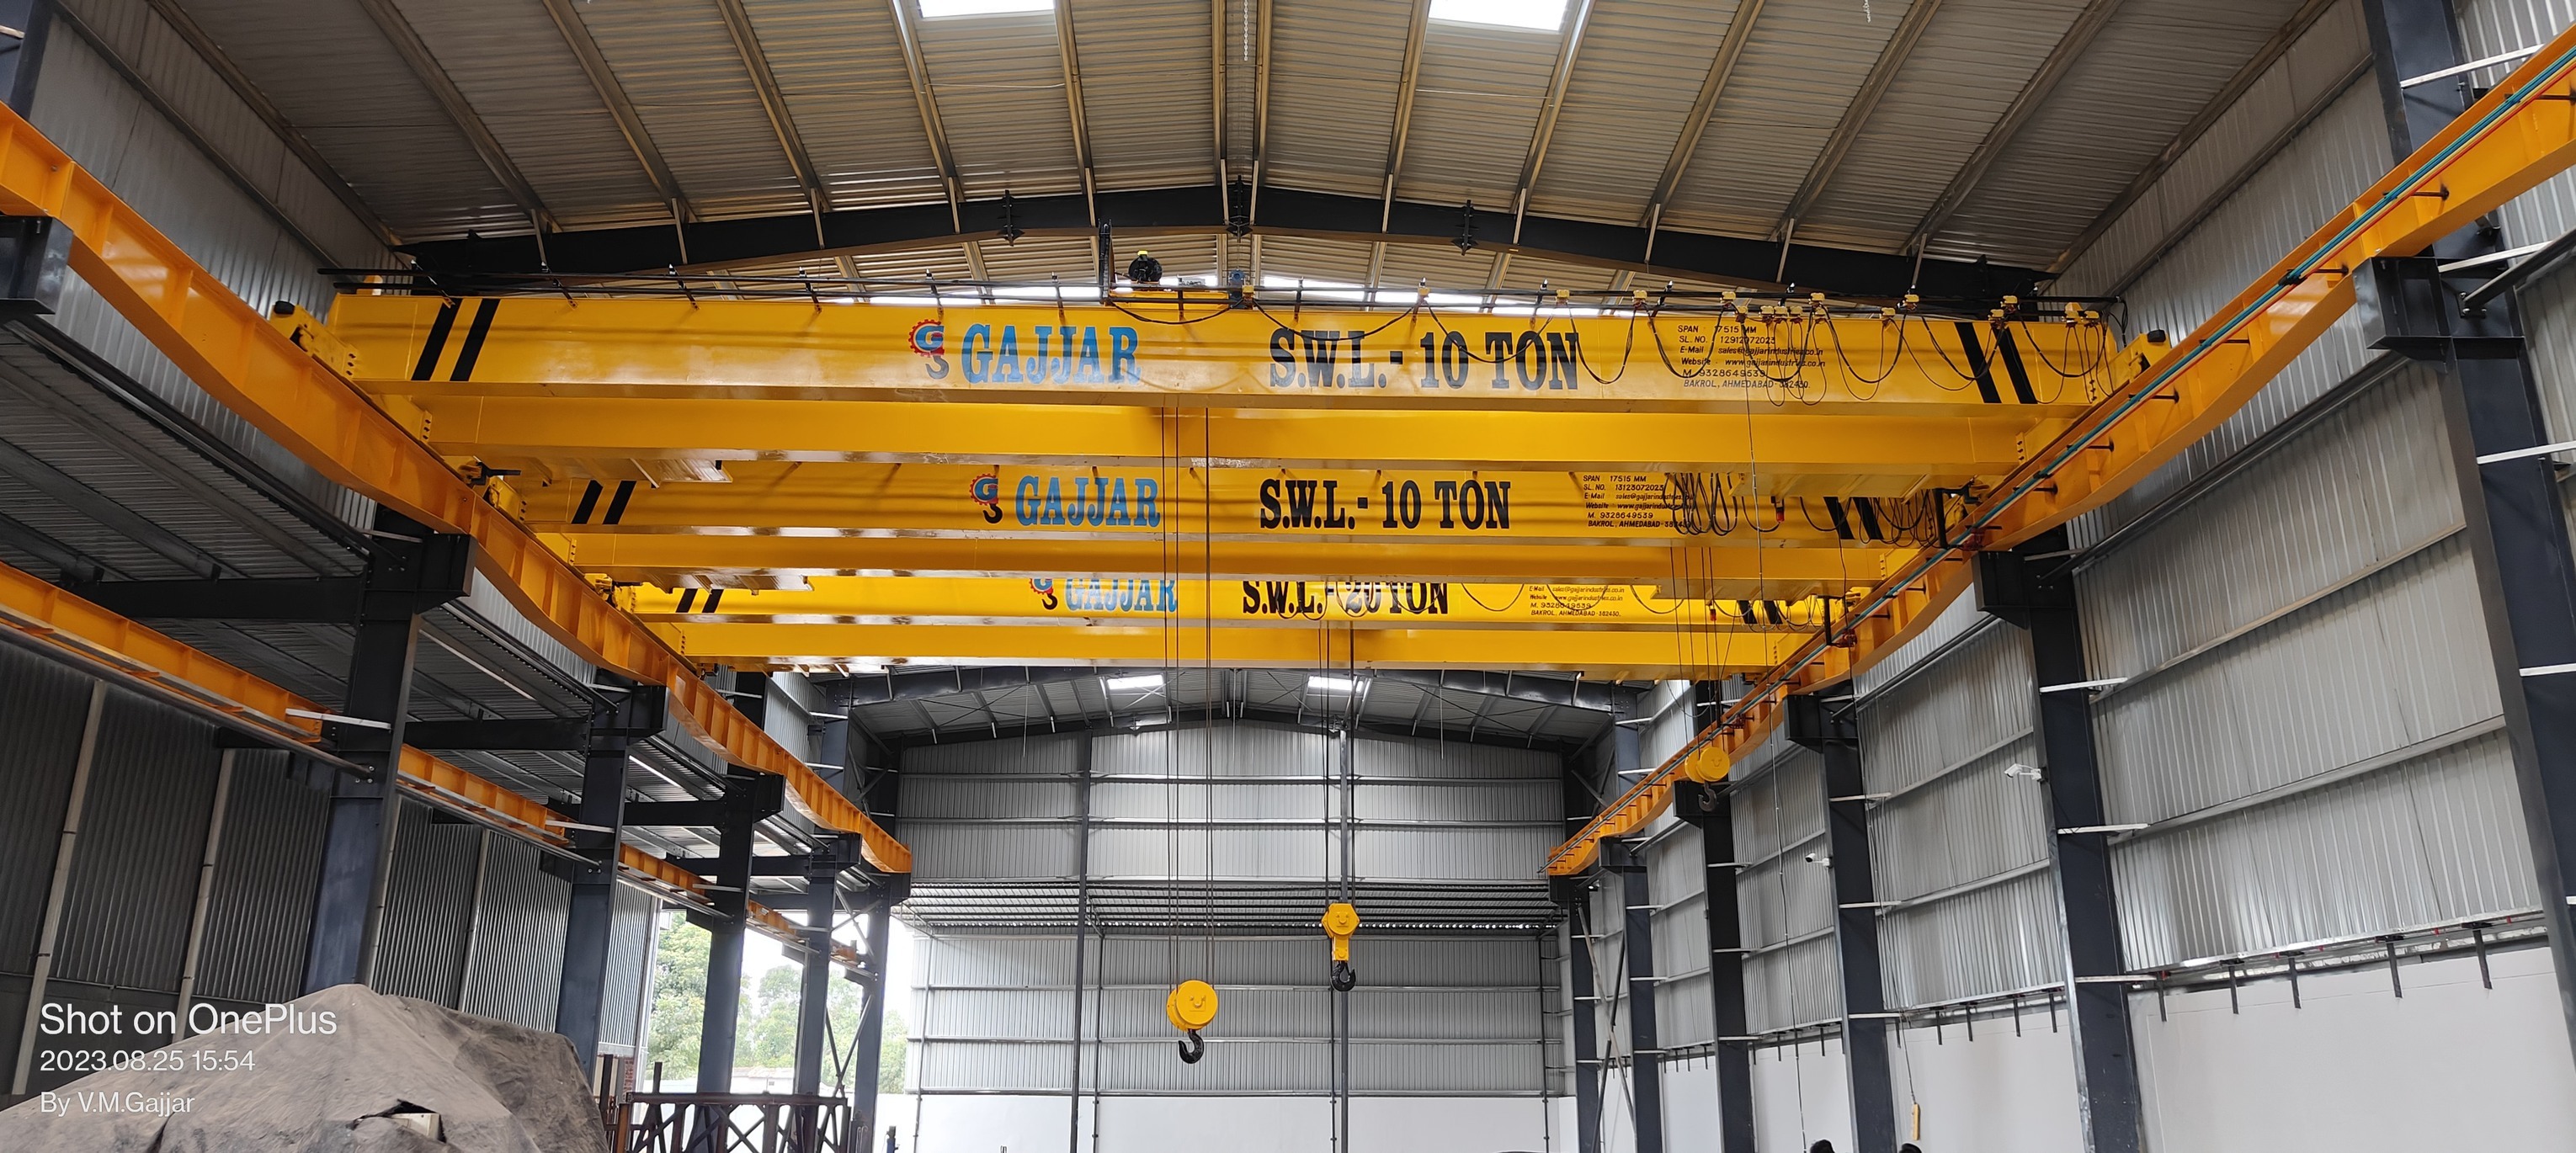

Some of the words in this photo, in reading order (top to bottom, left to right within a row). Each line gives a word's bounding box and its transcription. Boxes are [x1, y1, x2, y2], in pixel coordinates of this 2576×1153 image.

[1678, 325, 1699, 333] SPAN
[961, 323, 1142, 385] GAJJAR
[1420, 331, 1469, 389] 10
[1485, 331, 1578, 391] TON
[1718, 346, 1823, 357] sales@gajjarindustriesco.in
[1684, 380, 1720, 388] BAKROL,
[1699, 369, 1766, 378] 9328649539
[1015, 475, 1161, 527] GAJJAR
[1382, 480, 1423, 529] 10
[1434, 480, 1511, 529] TON
[1066, 578, 1178, 613] GAJJAR
[1344, 582, 1382, 614] 20
[1385, 582, 1448, 614] TON
